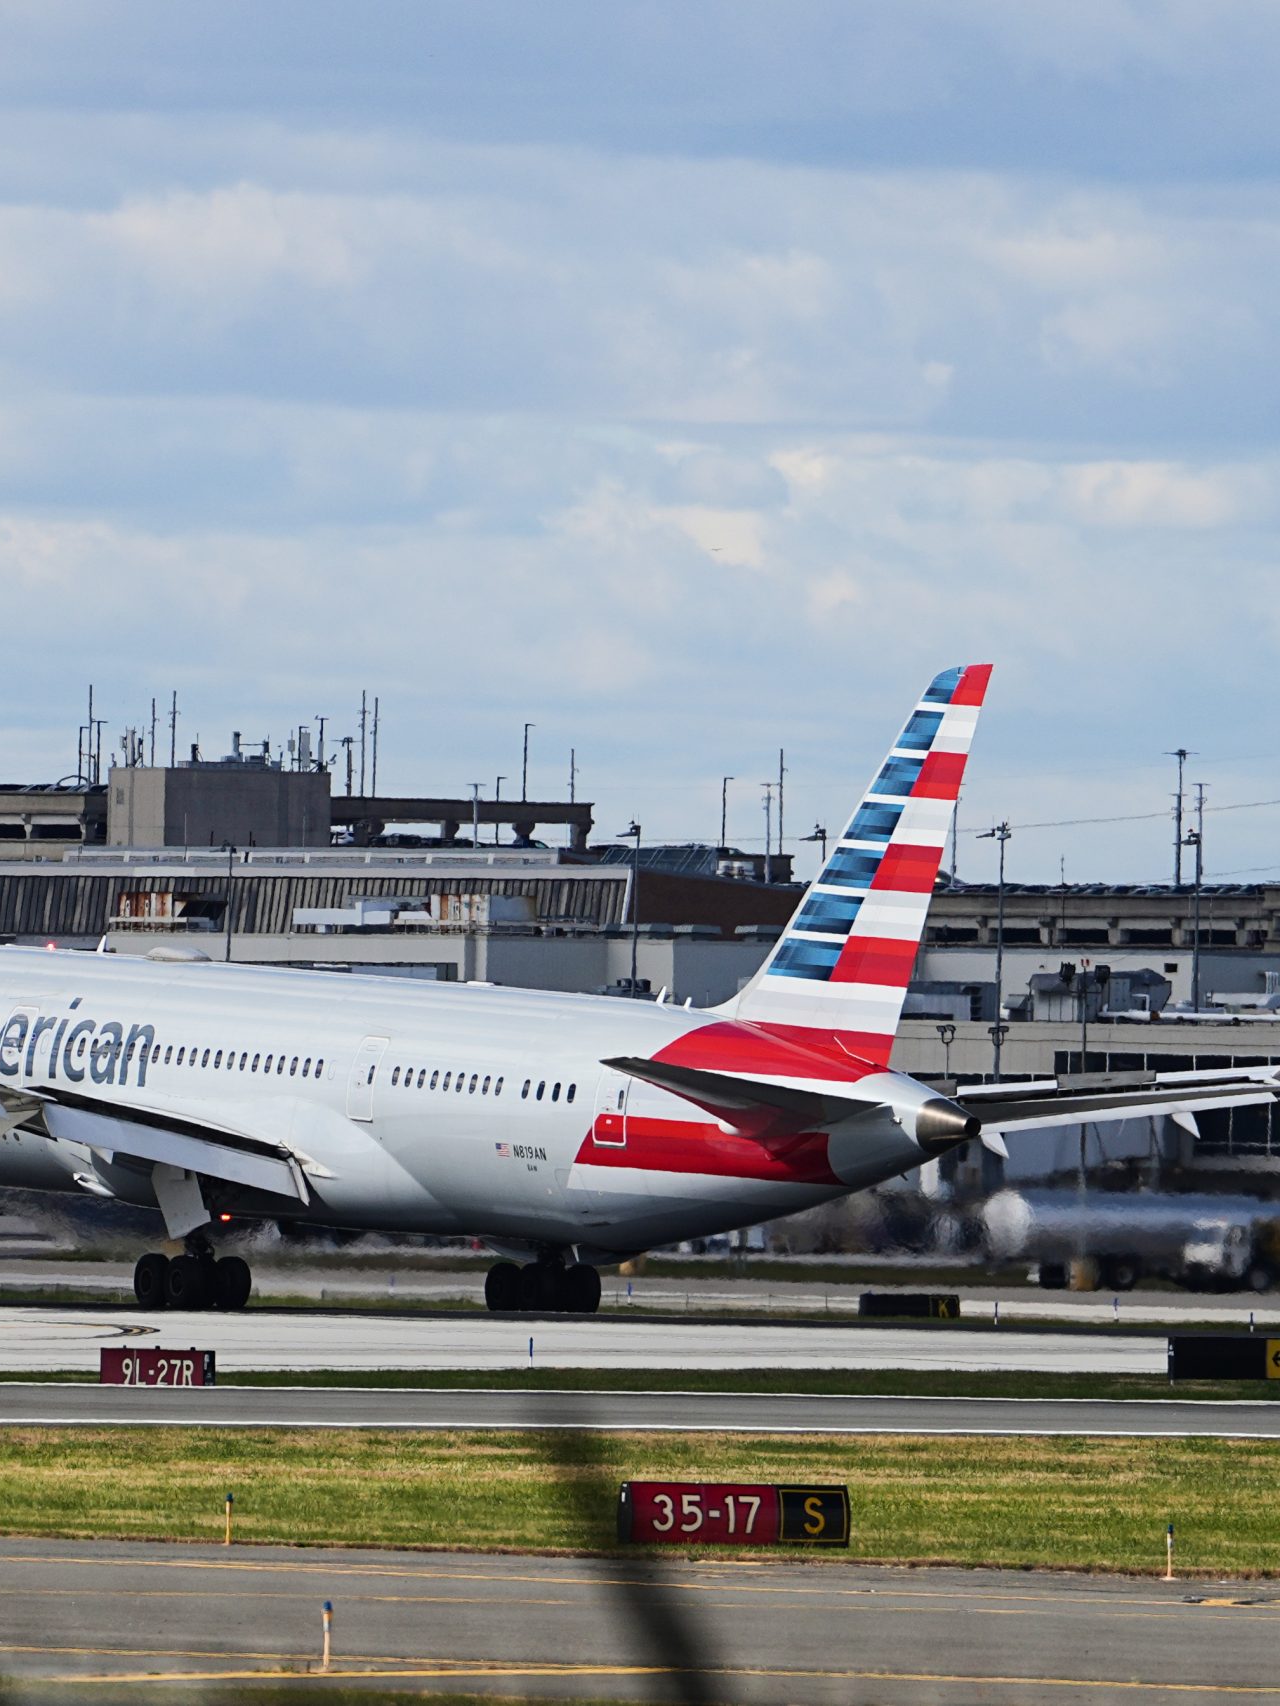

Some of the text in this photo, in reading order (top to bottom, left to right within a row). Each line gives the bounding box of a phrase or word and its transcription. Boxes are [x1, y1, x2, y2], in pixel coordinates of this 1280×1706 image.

[513, 1144, 547, 1161] N819AN
[122, 1358, 194, 1386] 9L-27R
[652, 1494, 826, 1534] 35-17 S
